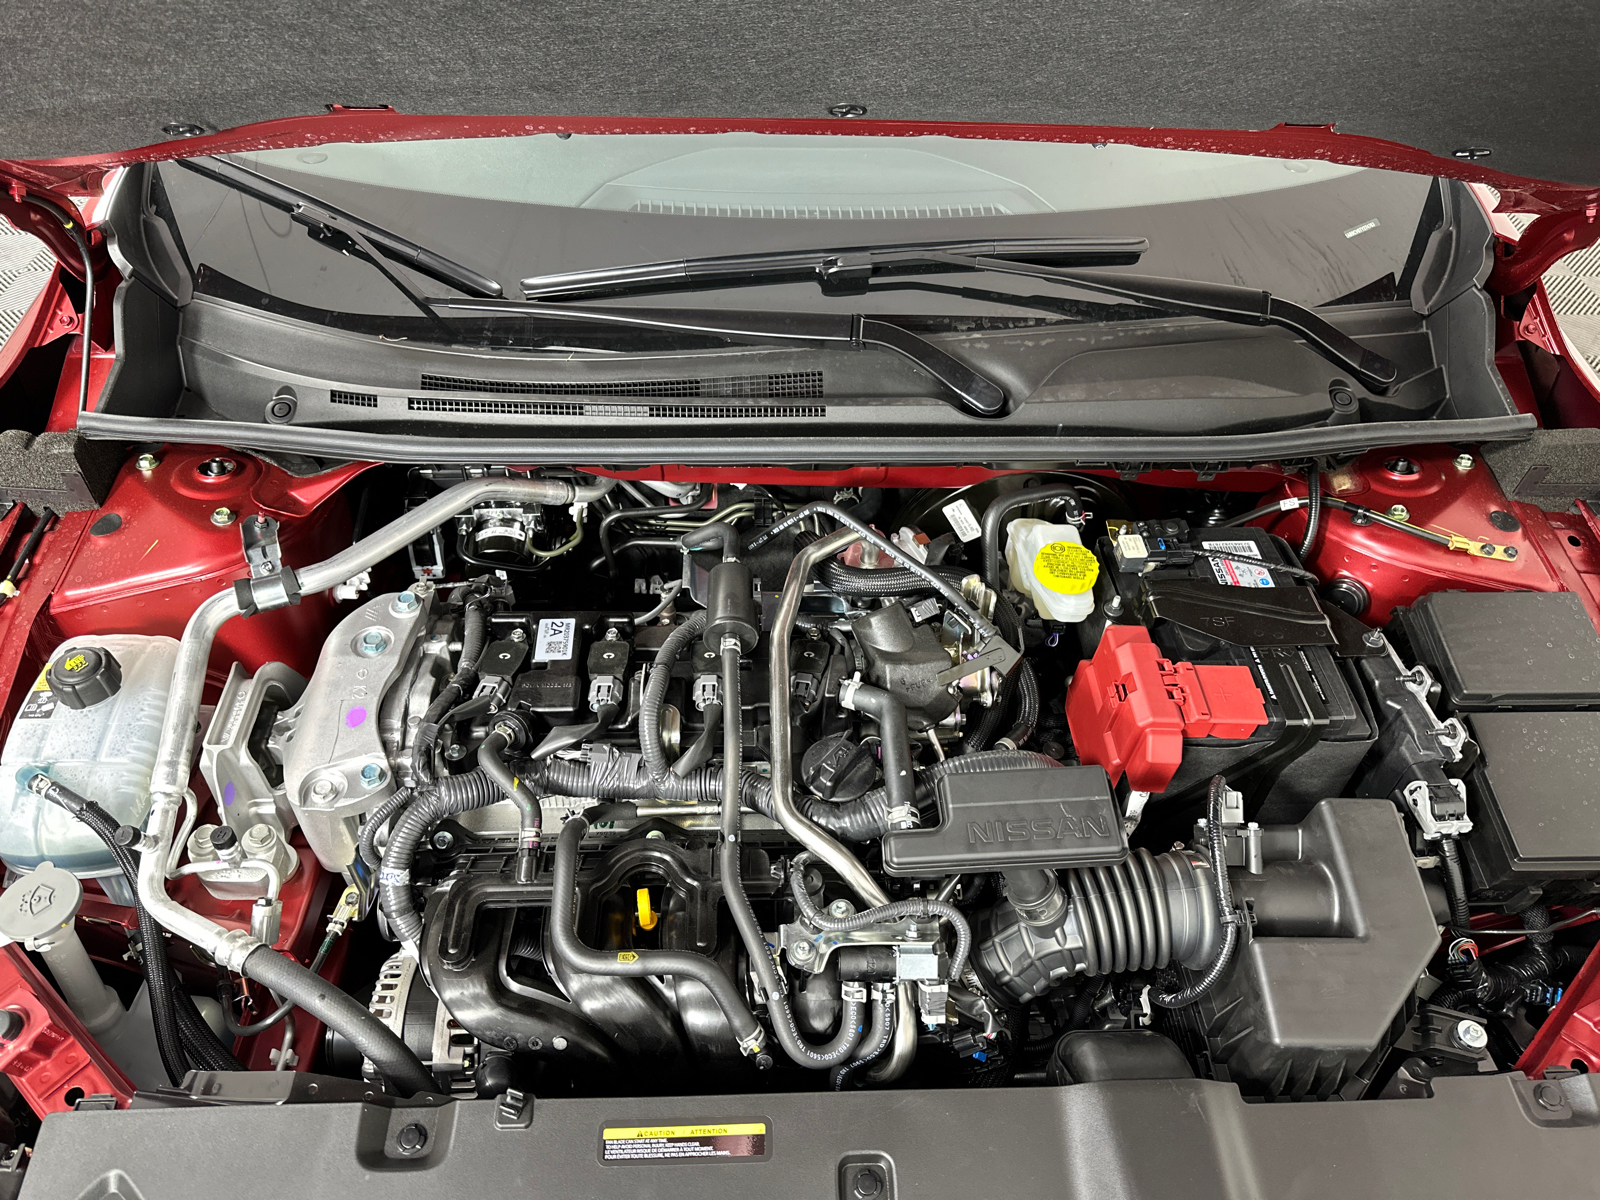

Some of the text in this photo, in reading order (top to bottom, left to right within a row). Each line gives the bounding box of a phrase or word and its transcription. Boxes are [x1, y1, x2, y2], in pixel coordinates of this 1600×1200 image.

[1283, 499, 1296, 508] FS
[550, 621, 564, 637] 2A
[1200, 616, 1235, 628] 7SF
[603, 652, 615, 660] C
[352, 684, 367, 700] K2
[967, 815, 1110, 844] NISSAN
